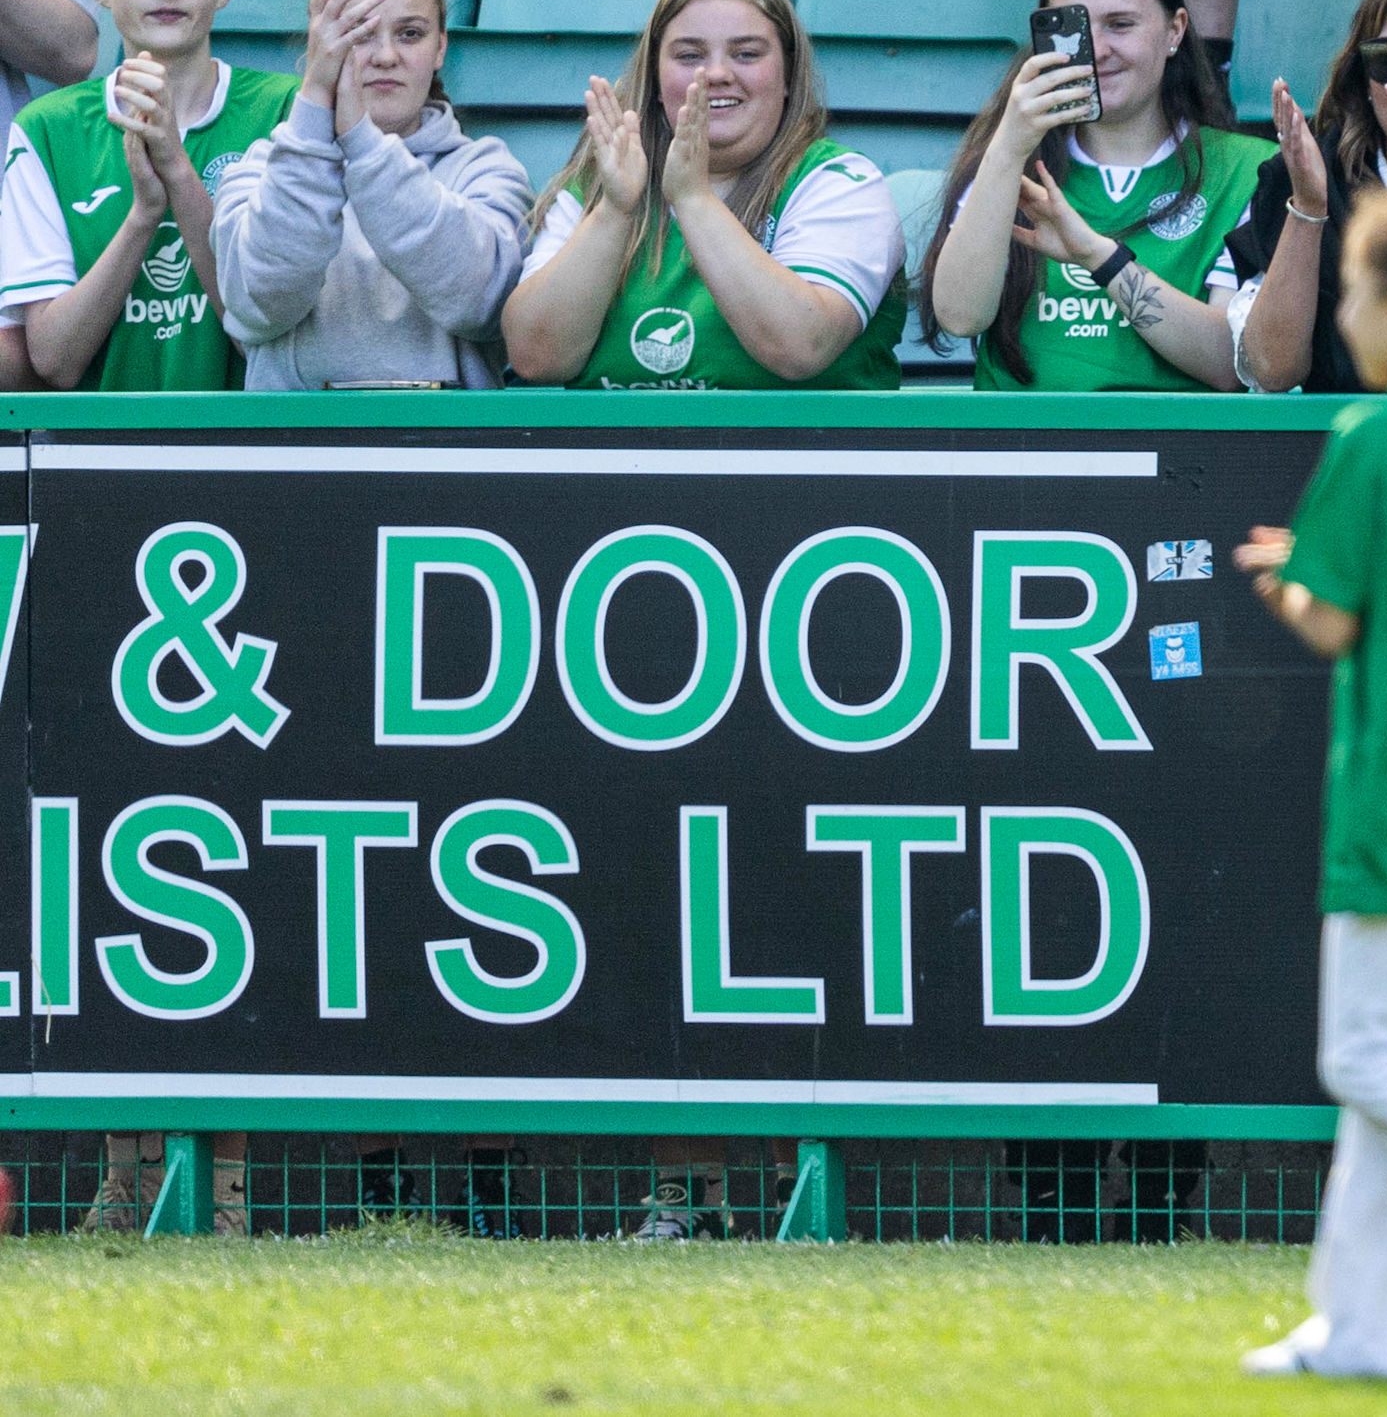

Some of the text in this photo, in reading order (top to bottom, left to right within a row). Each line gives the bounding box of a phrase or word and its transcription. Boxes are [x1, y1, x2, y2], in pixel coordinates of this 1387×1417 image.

[125, 293, 208, 323] bevvy
[1064, 324, 1108, 337] .com
[112, 521, 291, 750] &
[375, 524, 1153, 752] DOOR
[0, 794, 1153, 1028] ISTS LTD
